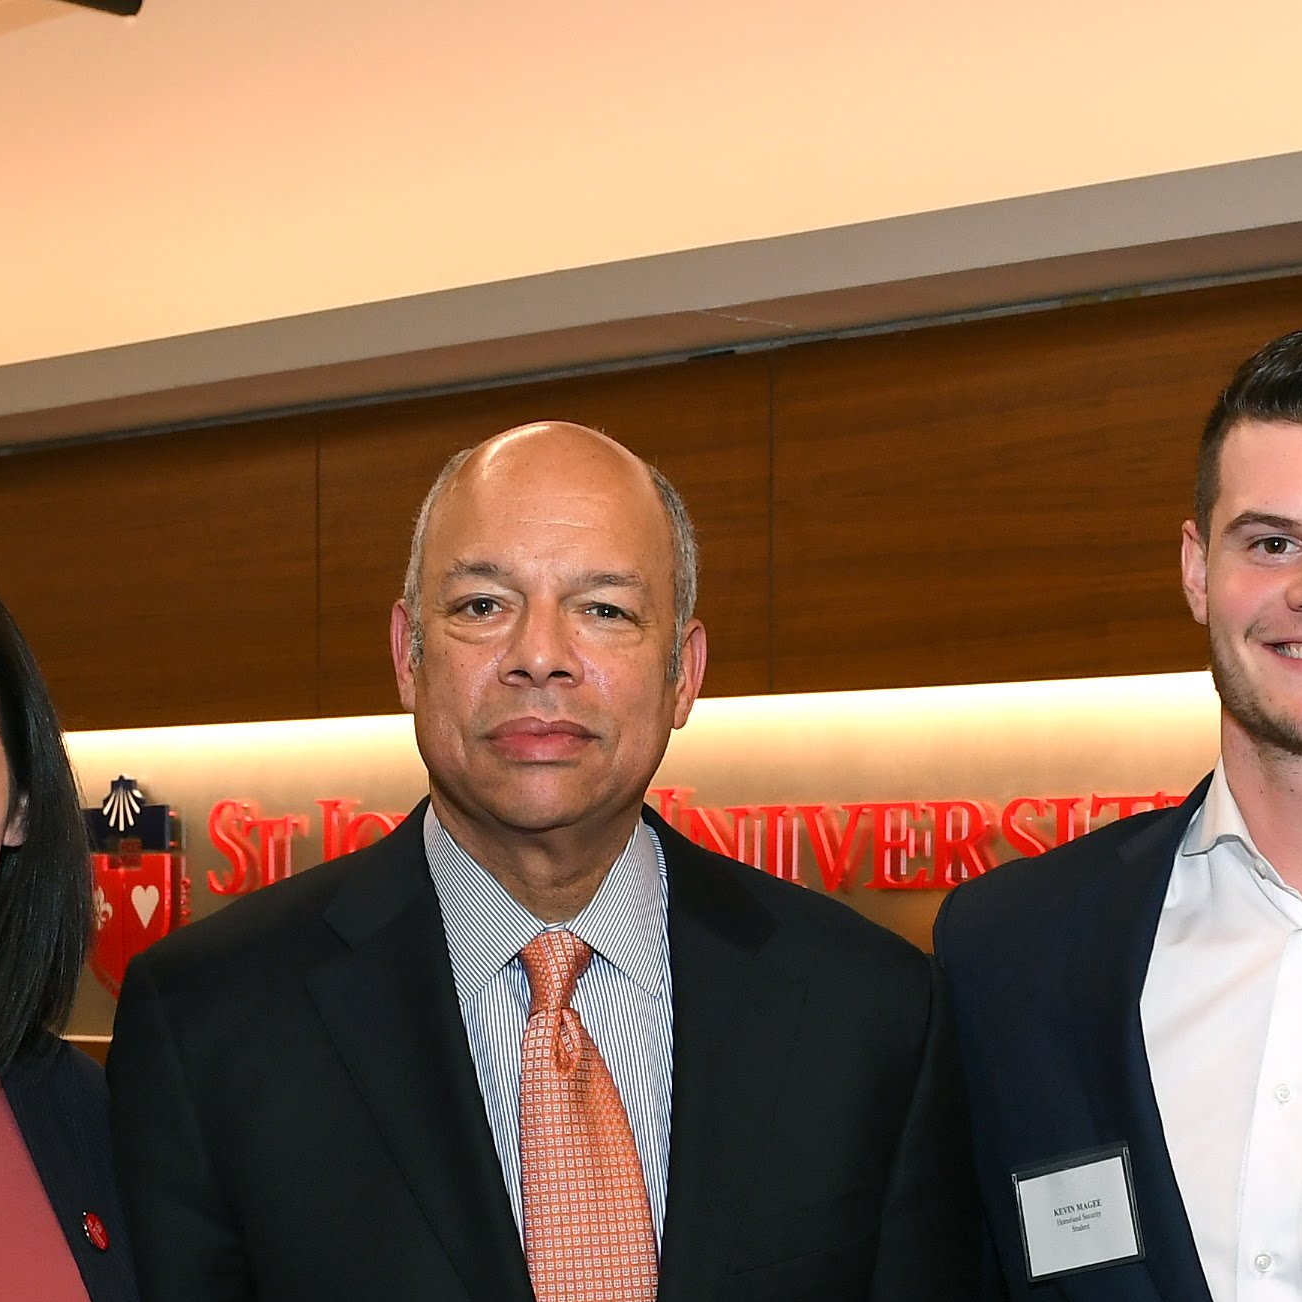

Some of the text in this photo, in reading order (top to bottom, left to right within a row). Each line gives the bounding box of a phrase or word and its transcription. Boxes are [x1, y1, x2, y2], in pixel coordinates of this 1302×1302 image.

[1053, 1199, 1101, 1216] KEVIN MAGEE
[1057, 1211, 1102, 1226] Homeland Security
[1072, 1224, 1090, 1232] Student
